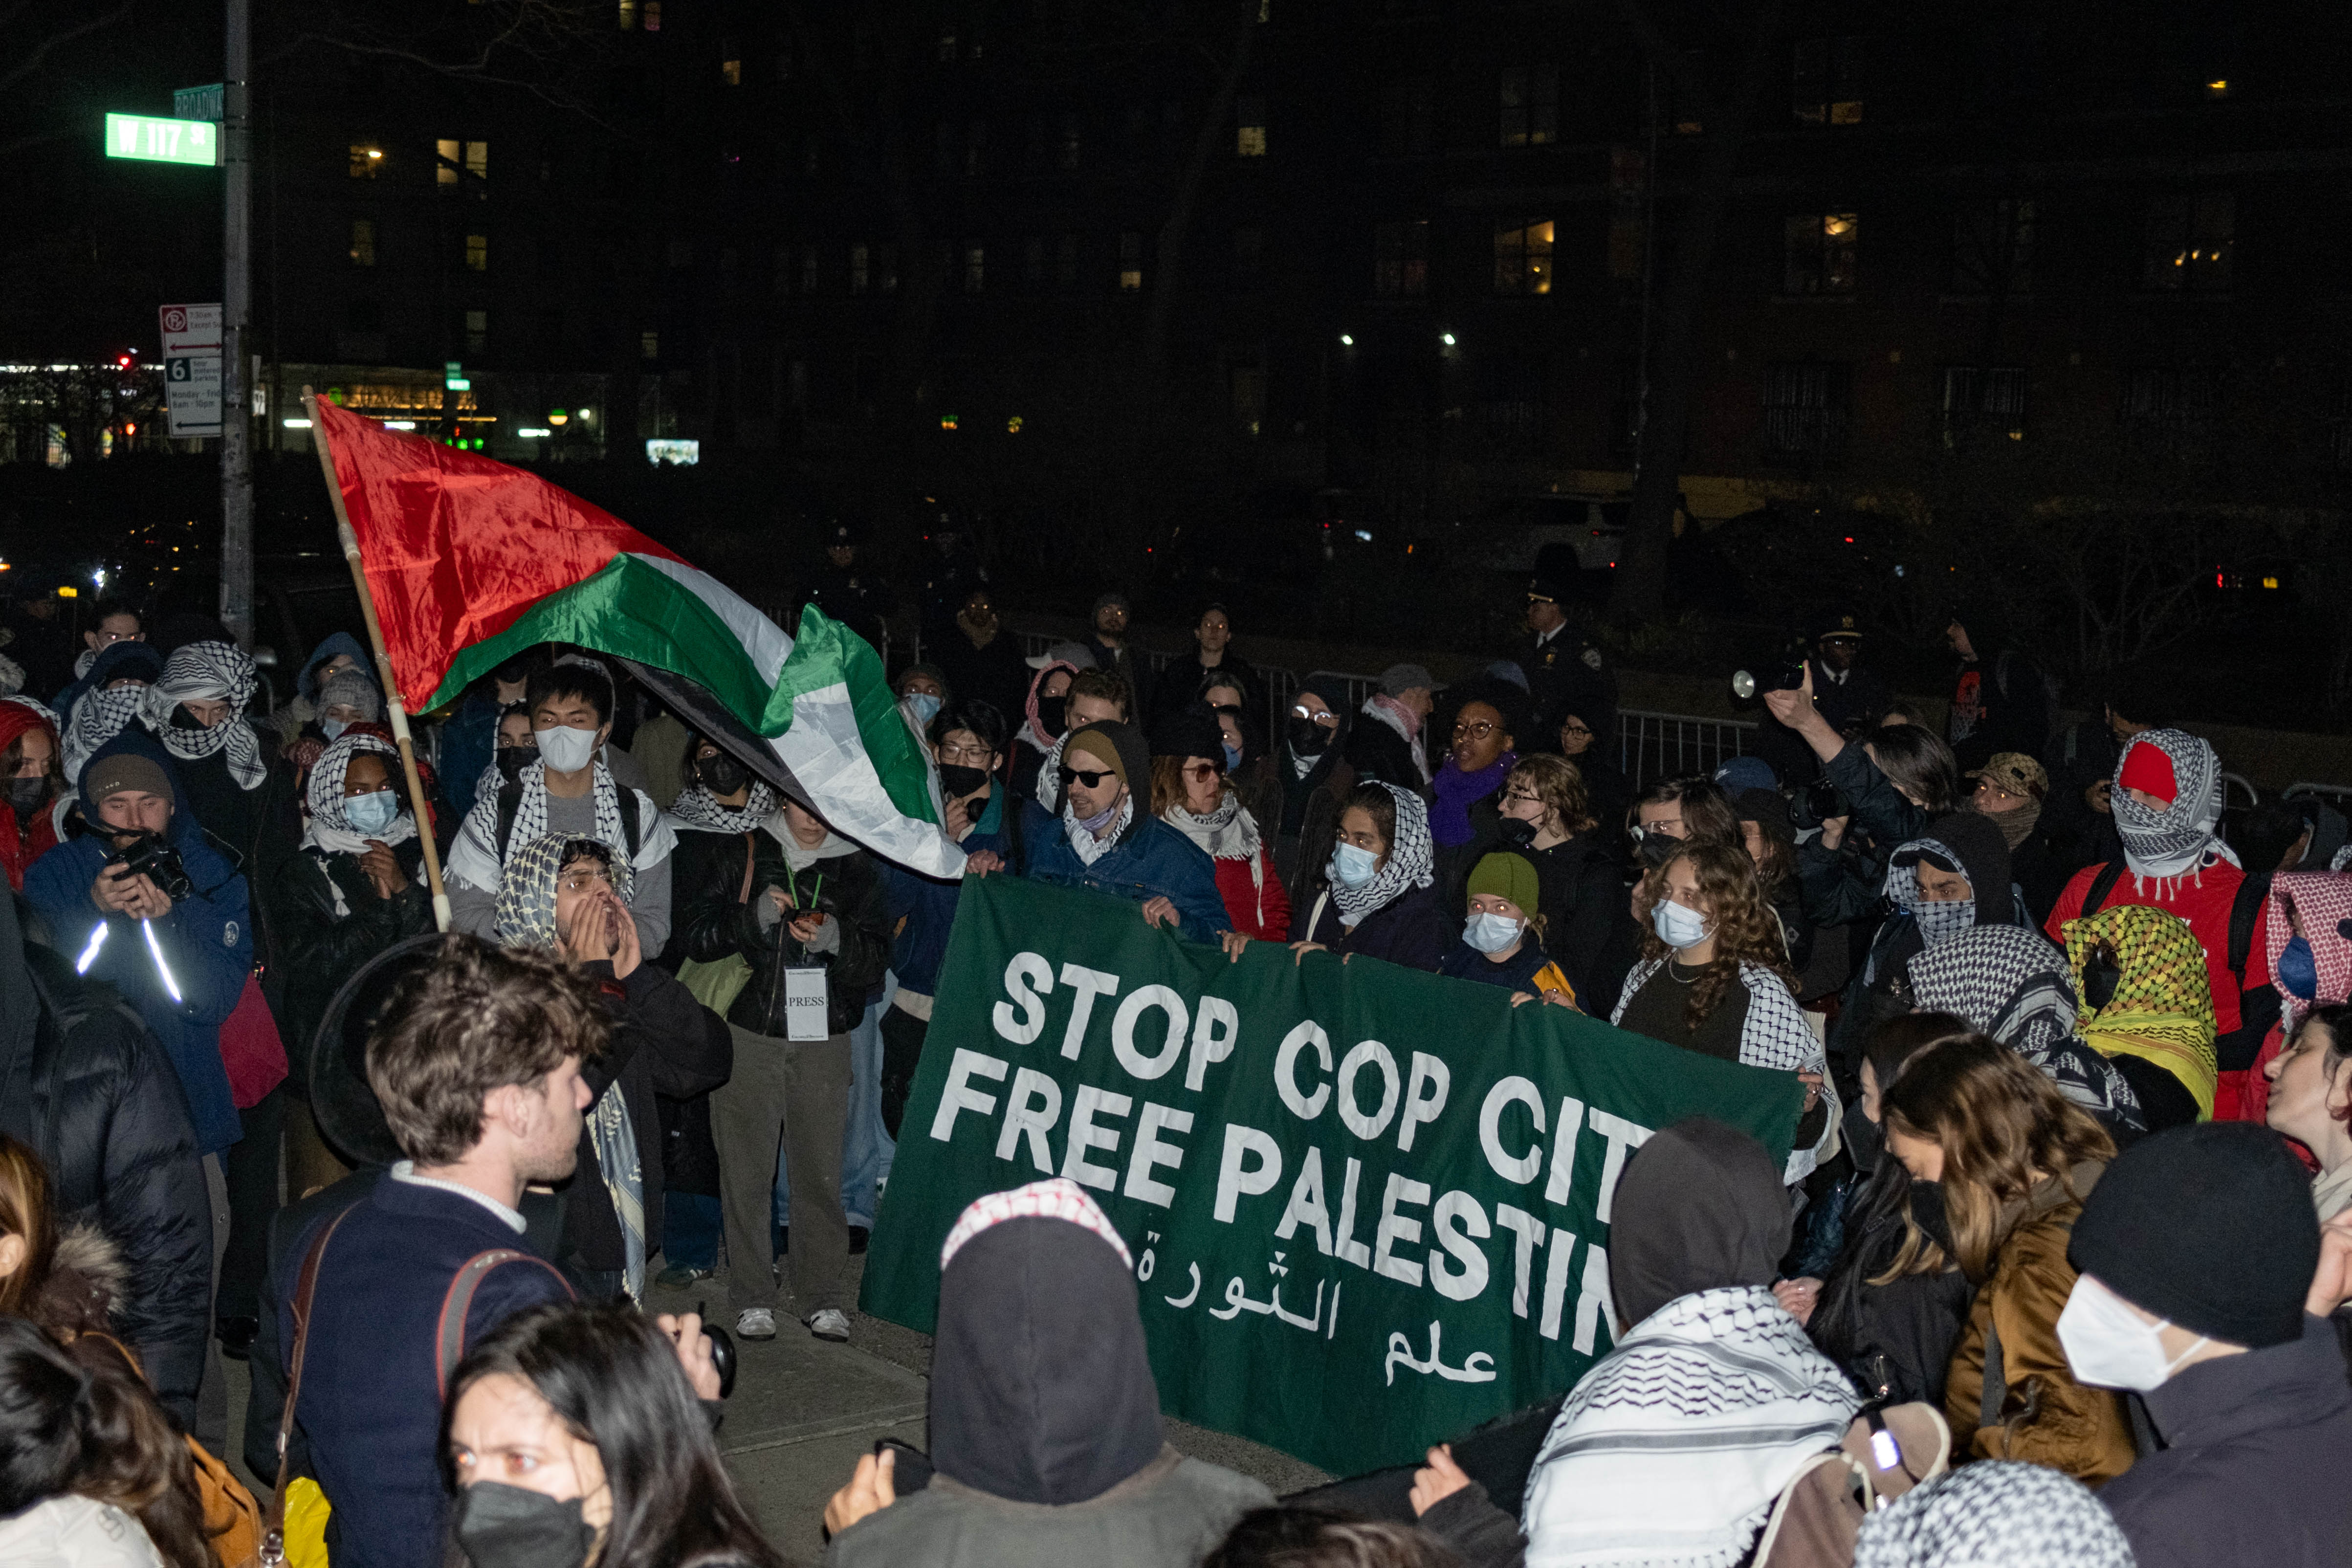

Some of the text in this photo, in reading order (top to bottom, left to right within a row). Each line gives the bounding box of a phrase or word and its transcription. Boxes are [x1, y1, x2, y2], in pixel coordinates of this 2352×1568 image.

[176, 89, 223, 120] BROADWA
[117, 120, 139, 153] W
[147, 123, 182, 156] 117
[172, 359, 186, 381] 6
[172, 391, 199, 399] Monday
[789, 996, 824, 1007] PRESS
[992, 952, 1657, 1224] STOP COP CIT
[930, 1047, 1617, 1356] FREE PALESTIN
[1138, 1231, 1496, 1386] علم الثورة
